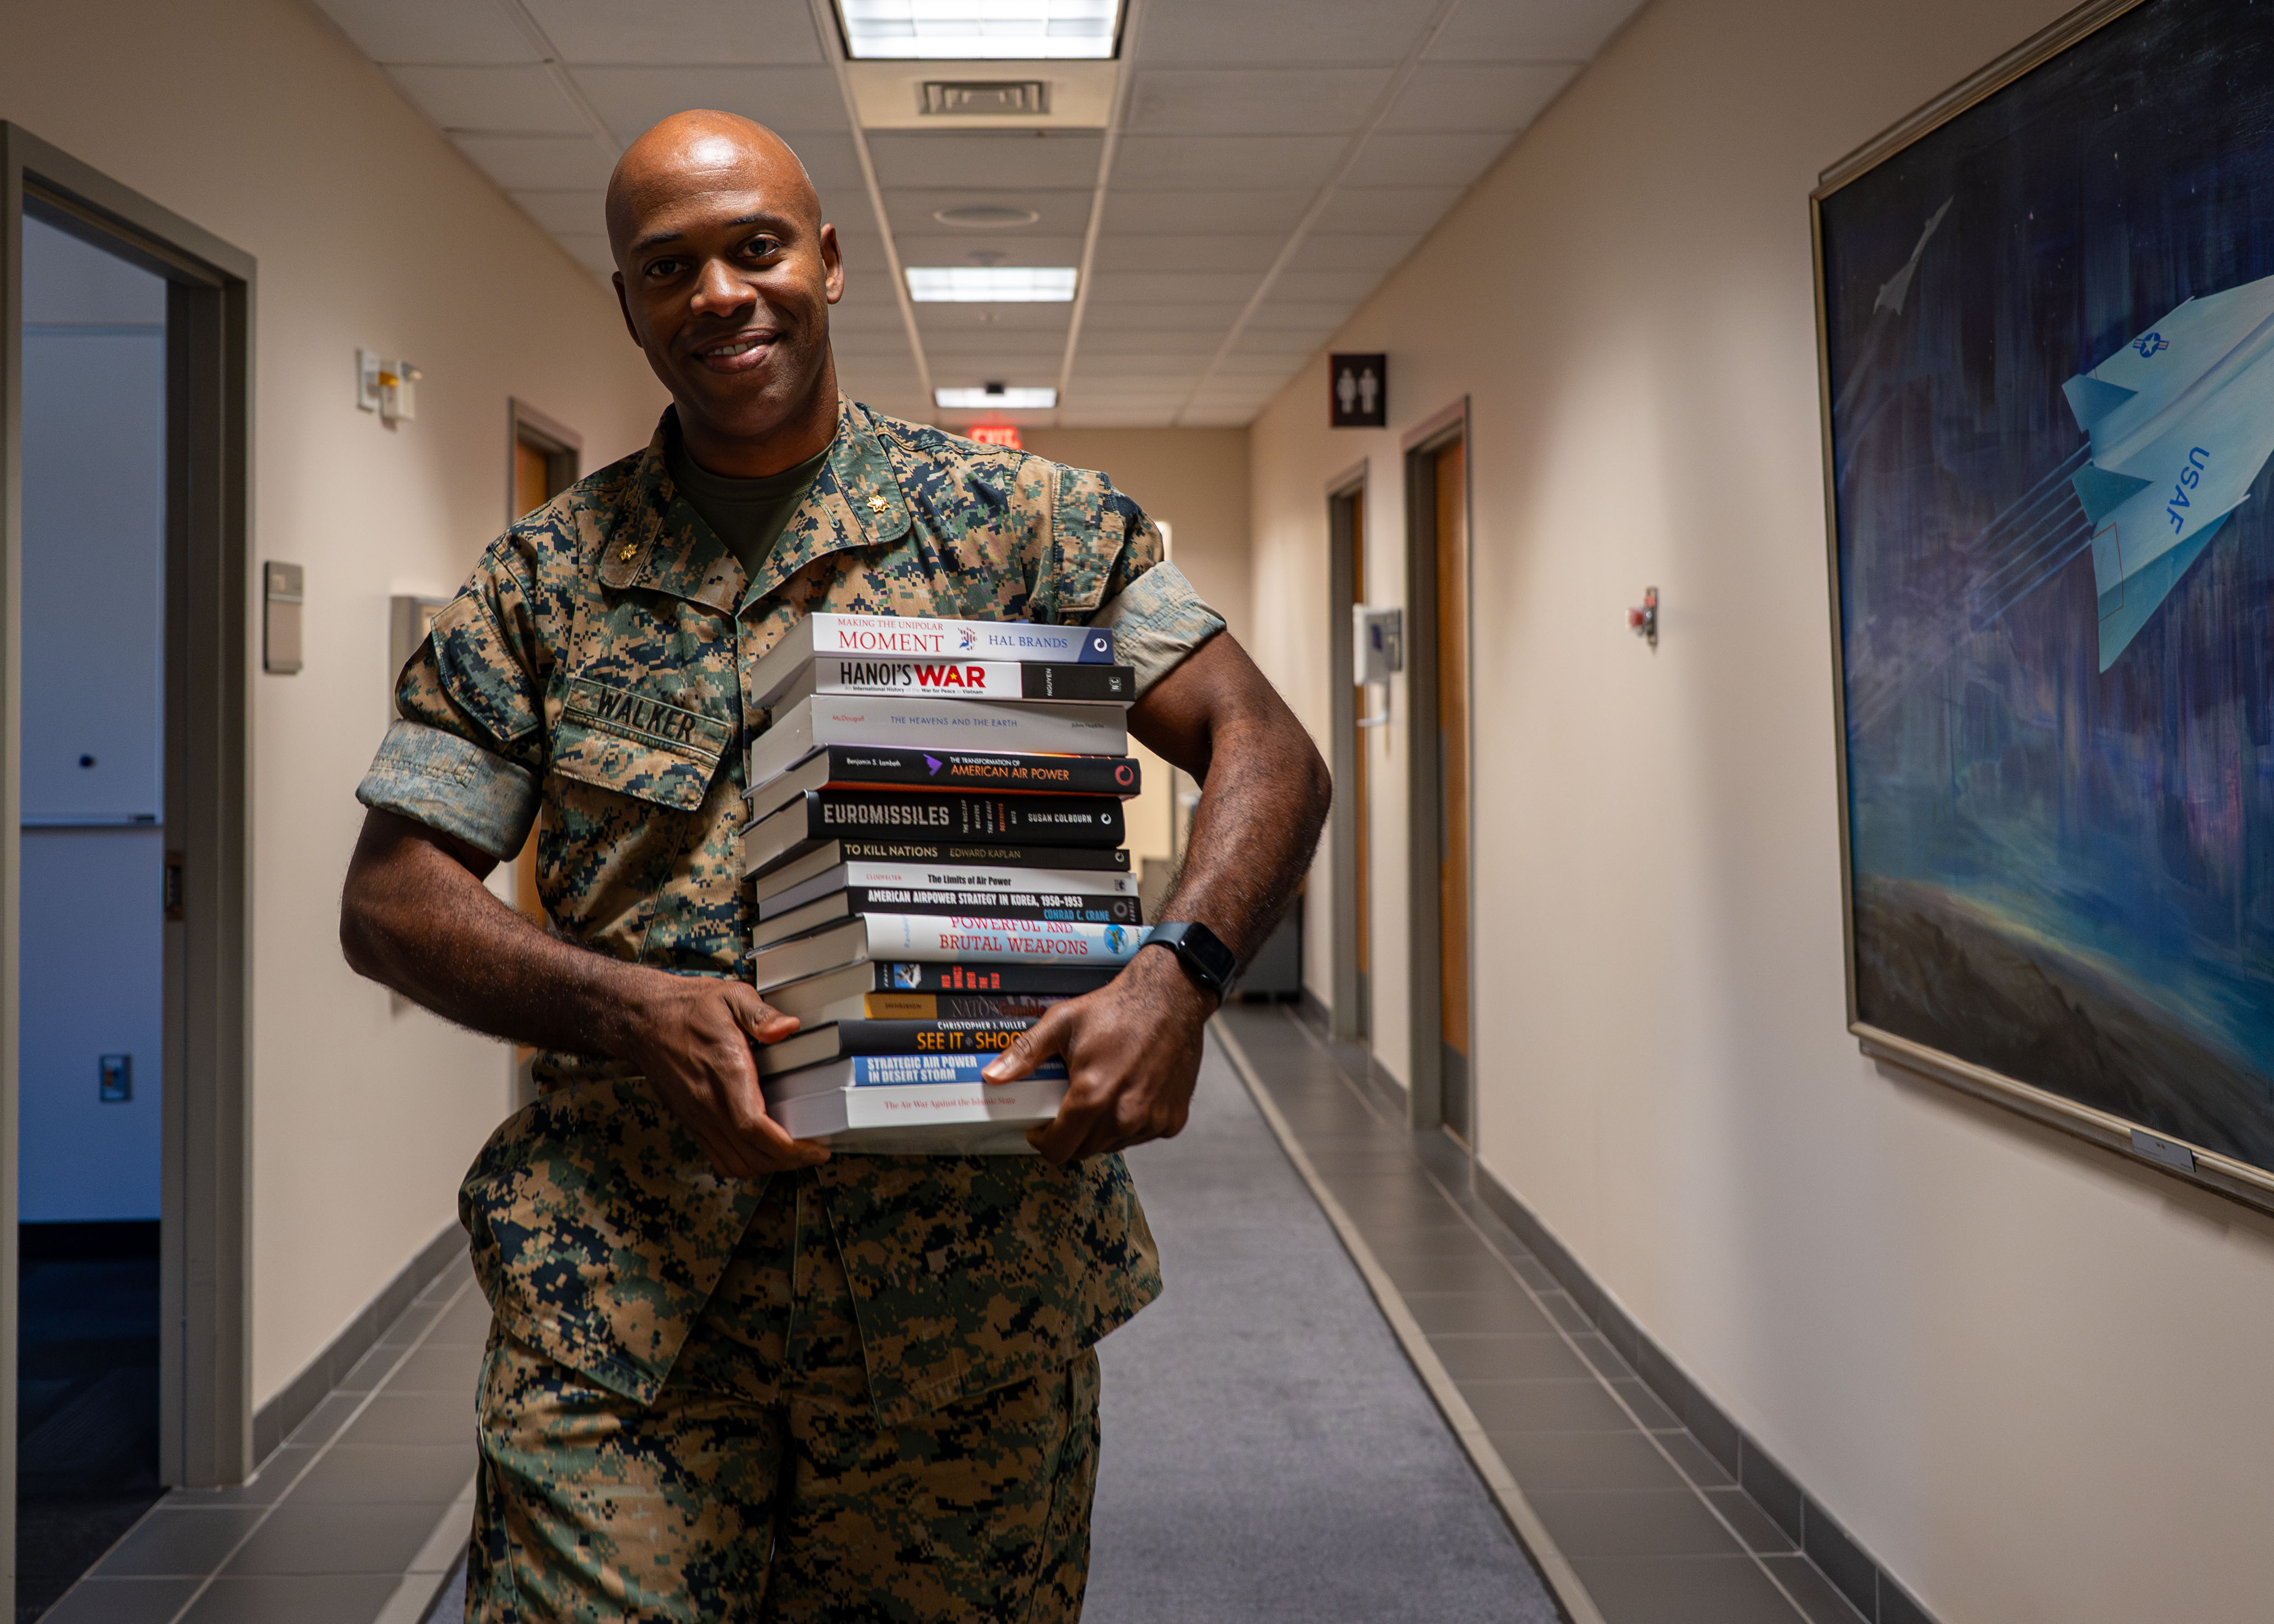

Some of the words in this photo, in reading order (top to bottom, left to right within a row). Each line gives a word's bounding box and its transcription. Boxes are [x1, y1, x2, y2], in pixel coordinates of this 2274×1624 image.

[2166, 446, 2210, 535] USAF
[838, 618, 875, 627] MAKING
[877, 620, 896, 629] THE
[899, 621, 944, 630] UNIPOLAR
[838, 630, 945, 653] MOMENT
[989, 635, 1015, 646] HAL
[1018, 636, 1068, 648] BRANDS
[840, 661, 912, 686] HANOI'S
[913, 664, 986, 688] WAR
[1045, 667, 1053, 696] NGUYEN
[597, 687, 696, 743] WALKER
[890, 716, 906, 724] THE
[909, 716, 948, 725] HEAVENS
[952, 718, 970, 726] AND
[973, 718, 988, 727] THE
[992, 718, 1017, 727] EARTH
[846, 757, 872, 767] Benjamin
[962, 757, 1011, 767] TRANSFORMATION
[951, 764, 1009, 778] AMERICAN
[1011, 767, 1028, 780] AIR
[1031, 768, 1069, 781] POWER
[823, 803, 950, 826] EUROMISSILES
[1028, 813, 1053, 822] SUSAN
[1054, 813, 1092, 823] COLBOURN
[844, 843, 861, 855] TO
[863, 844, 887, 856] KILL
[889, 845, 938, 857] NATIONS
[949, 848, 986, 858] EDWARD
[988, 850, 1021, 859] KAPLAN
[928, 873, 942, 884] The
[943, 874, 966, 885] Limits
[968, 876, 976, 885] of
[976, 876, 987, 885] Air
[988, 877, 1011, 886] Power
[867, 889, 911, 903] AMERICAN
[913, 890, 957, 905] AIRPOWER
[958, 892, 997, 906] STRATEGY
[999, 894, 1009, 906] IN
[1010, 894, 1040, 907] KOREA,
[1044, 908, 1075, 920] CONRAD
[1076, 909, 1084, 921] C.
[1085, 909, 1110, 922] CRANE
[950, 915, 1041, 933] POWERFUL
[1046, 921, 1073, 934] AND
[939, 934, 1002, 952] BRUTAL
[1006, 936, 1089, 955] WEAPONS
[937, 1021, 991, 1030] CHRISTOPHER
[993, 1021, 999, 1030] J.
[1000, 1021, 1027, 1030] FULLER
[917, 1032, 945, 1050] SEE
[949, 1032, 964, 1050] IT
[975, 1030, 1025, 1050] SHOO
[867, 1056, 922, 1070] STRATEGIC
[923, 1056, 941, 1068] AIR
[941, 1055, 978, 1068] POWER
[868, 1070, 880, 1084] IN
[882, 1069, 919, 1083] DESERT
[920, 1068, 957, 1081] STORM
[884, 1100, 899, 1110] The
[901, 1100, 912, 1109] Air
[913, 1100, 928, 1109] War
[930, 1098, 957, 1110] Against
[958, 1097, 971, 1107] the
[972, 1096, 997, 1107] Islamic
